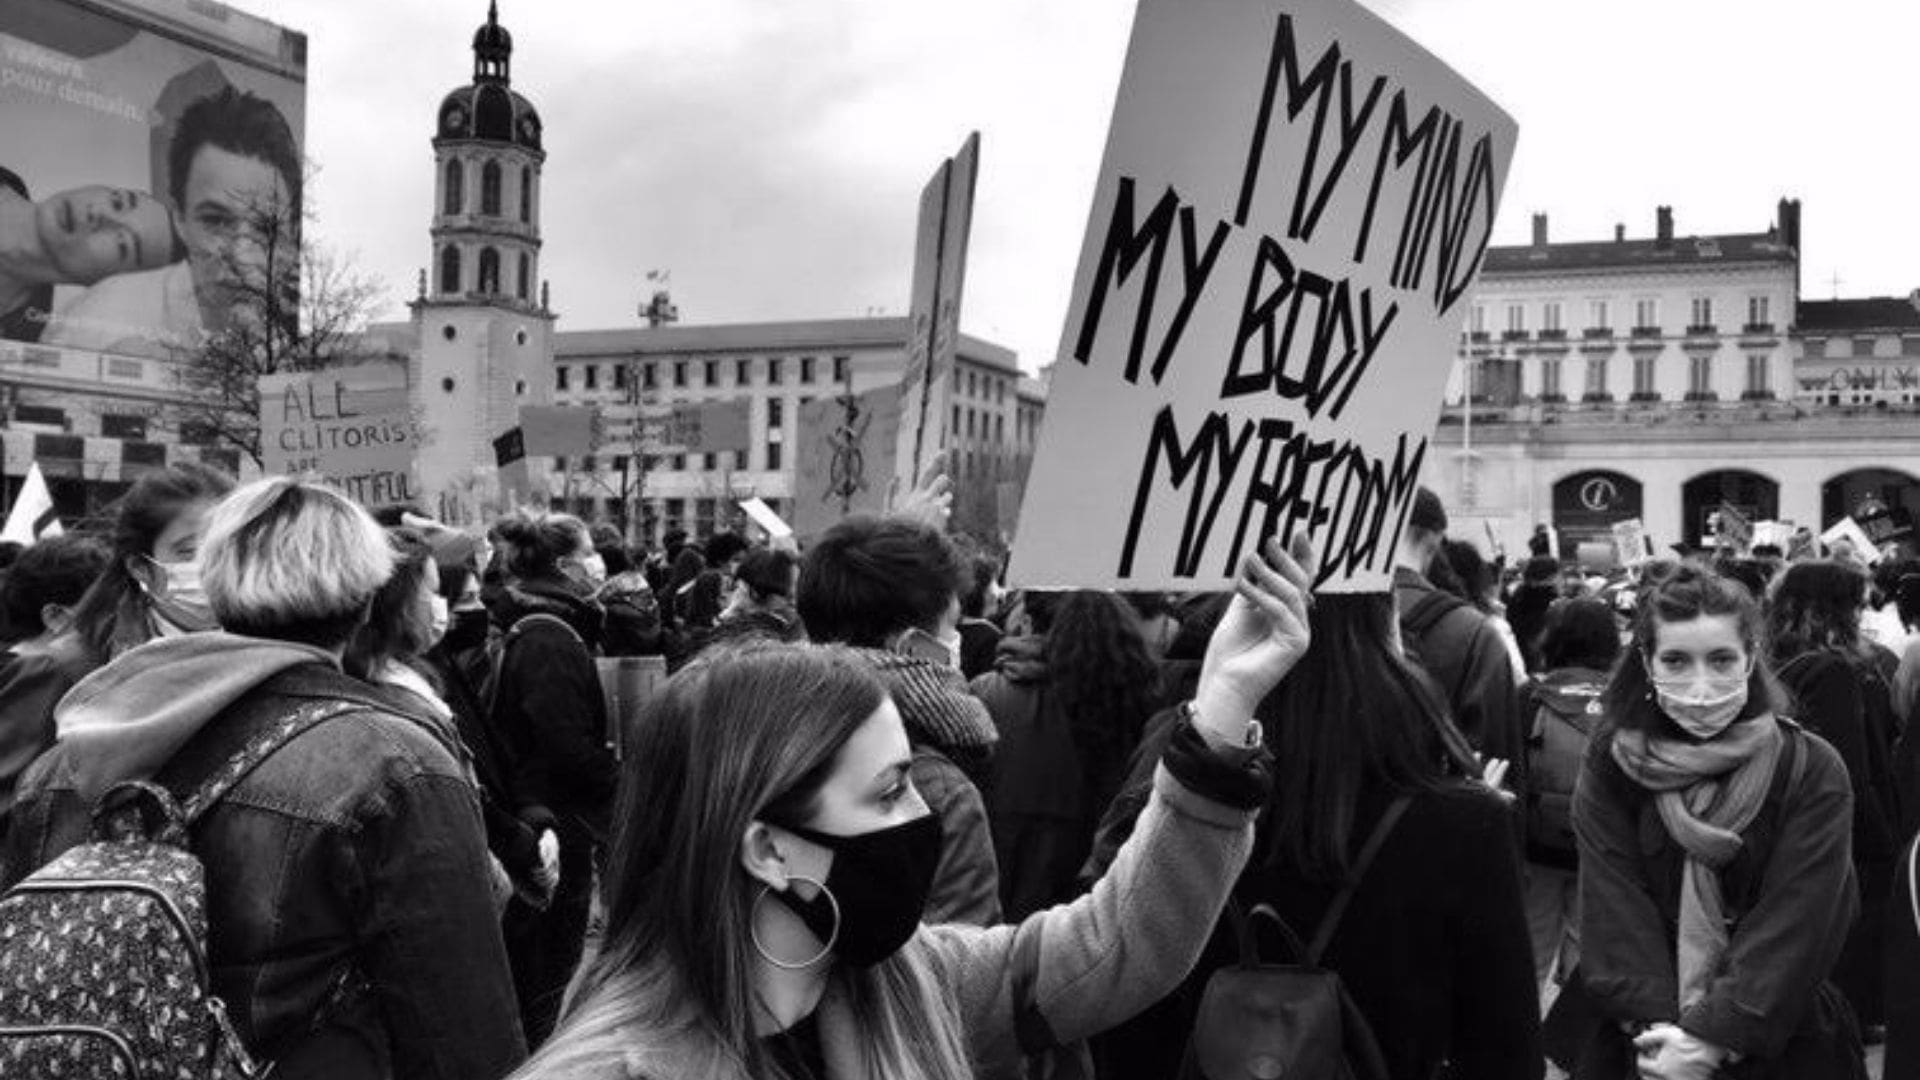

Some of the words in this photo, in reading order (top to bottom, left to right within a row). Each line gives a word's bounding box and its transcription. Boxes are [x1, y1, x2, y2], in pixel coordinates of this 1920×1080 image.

[1234, 13, 1388, 242] MY
[1354, 87, 1496, 317] MIND
[284, 379, 366, 422] ALL
[1074, 176, 1231, 386] MY
[1220, 234, 1398, 420] BODY
[1118, 403, 1256, 579] MY
[1224, 418, 1427, 593] FREEDOM
